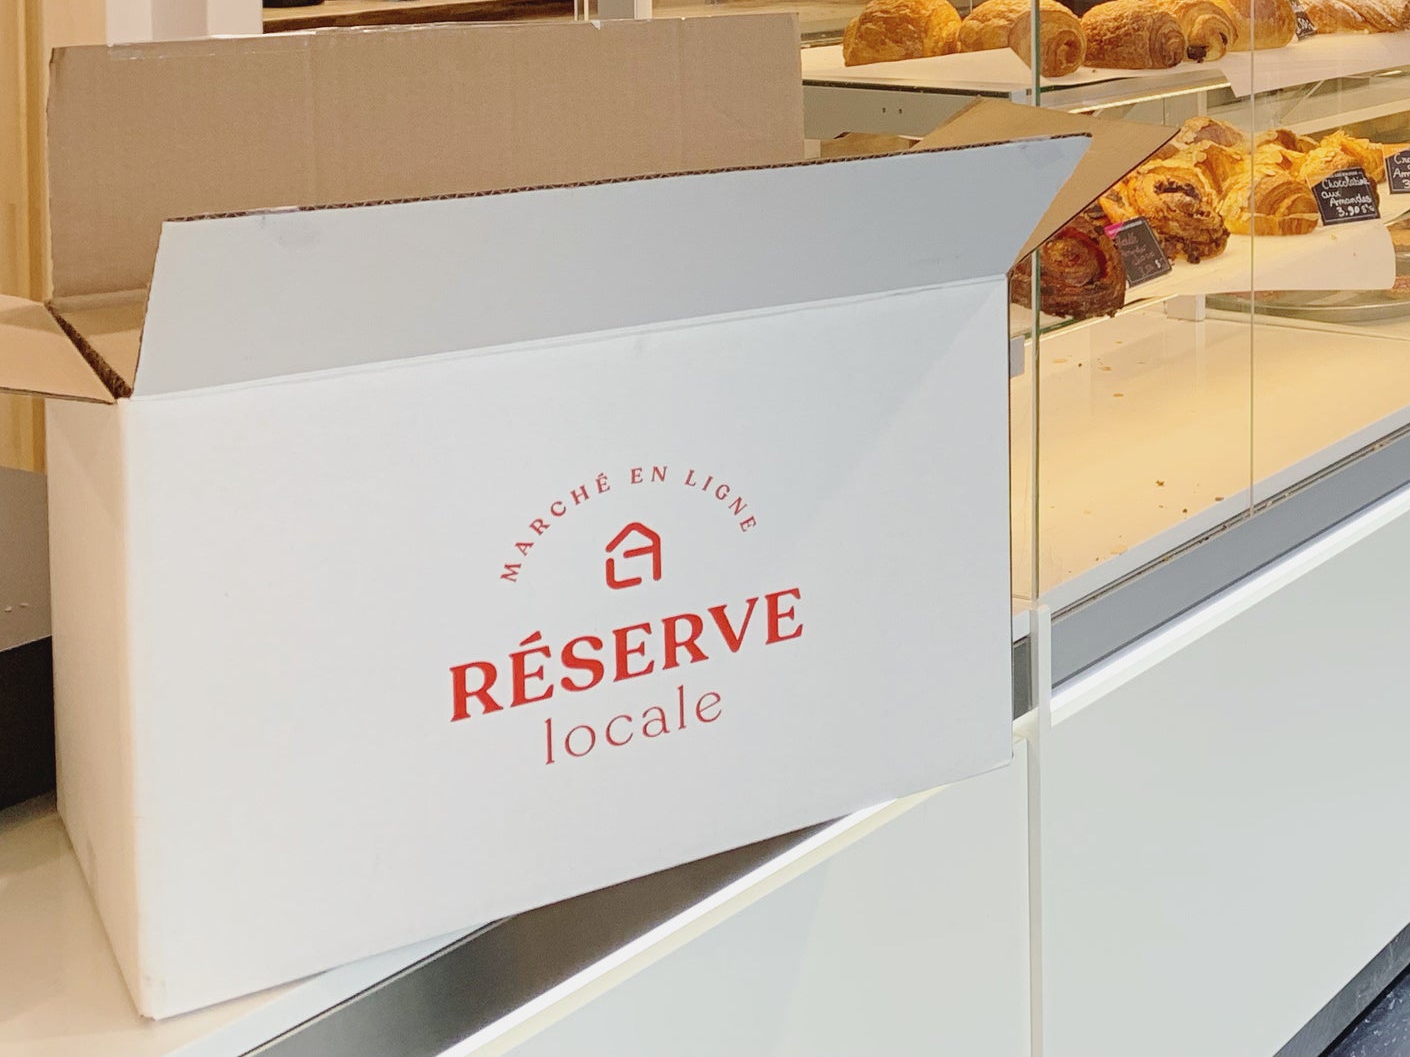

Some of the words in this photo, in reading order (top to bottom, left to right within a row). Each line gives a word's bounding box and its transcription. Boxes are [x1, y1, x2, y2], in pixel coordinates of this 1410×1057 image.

[1321, 190, 1342, 199] aux
[500, 472, 611, 583] MARCHÉ
[630, 465, 668, 485] EN
[684, 469, 757, 533] LIGNE
[449, 587, 804, 722] RÉSERVE
[544, 684, 723, 765] locale
